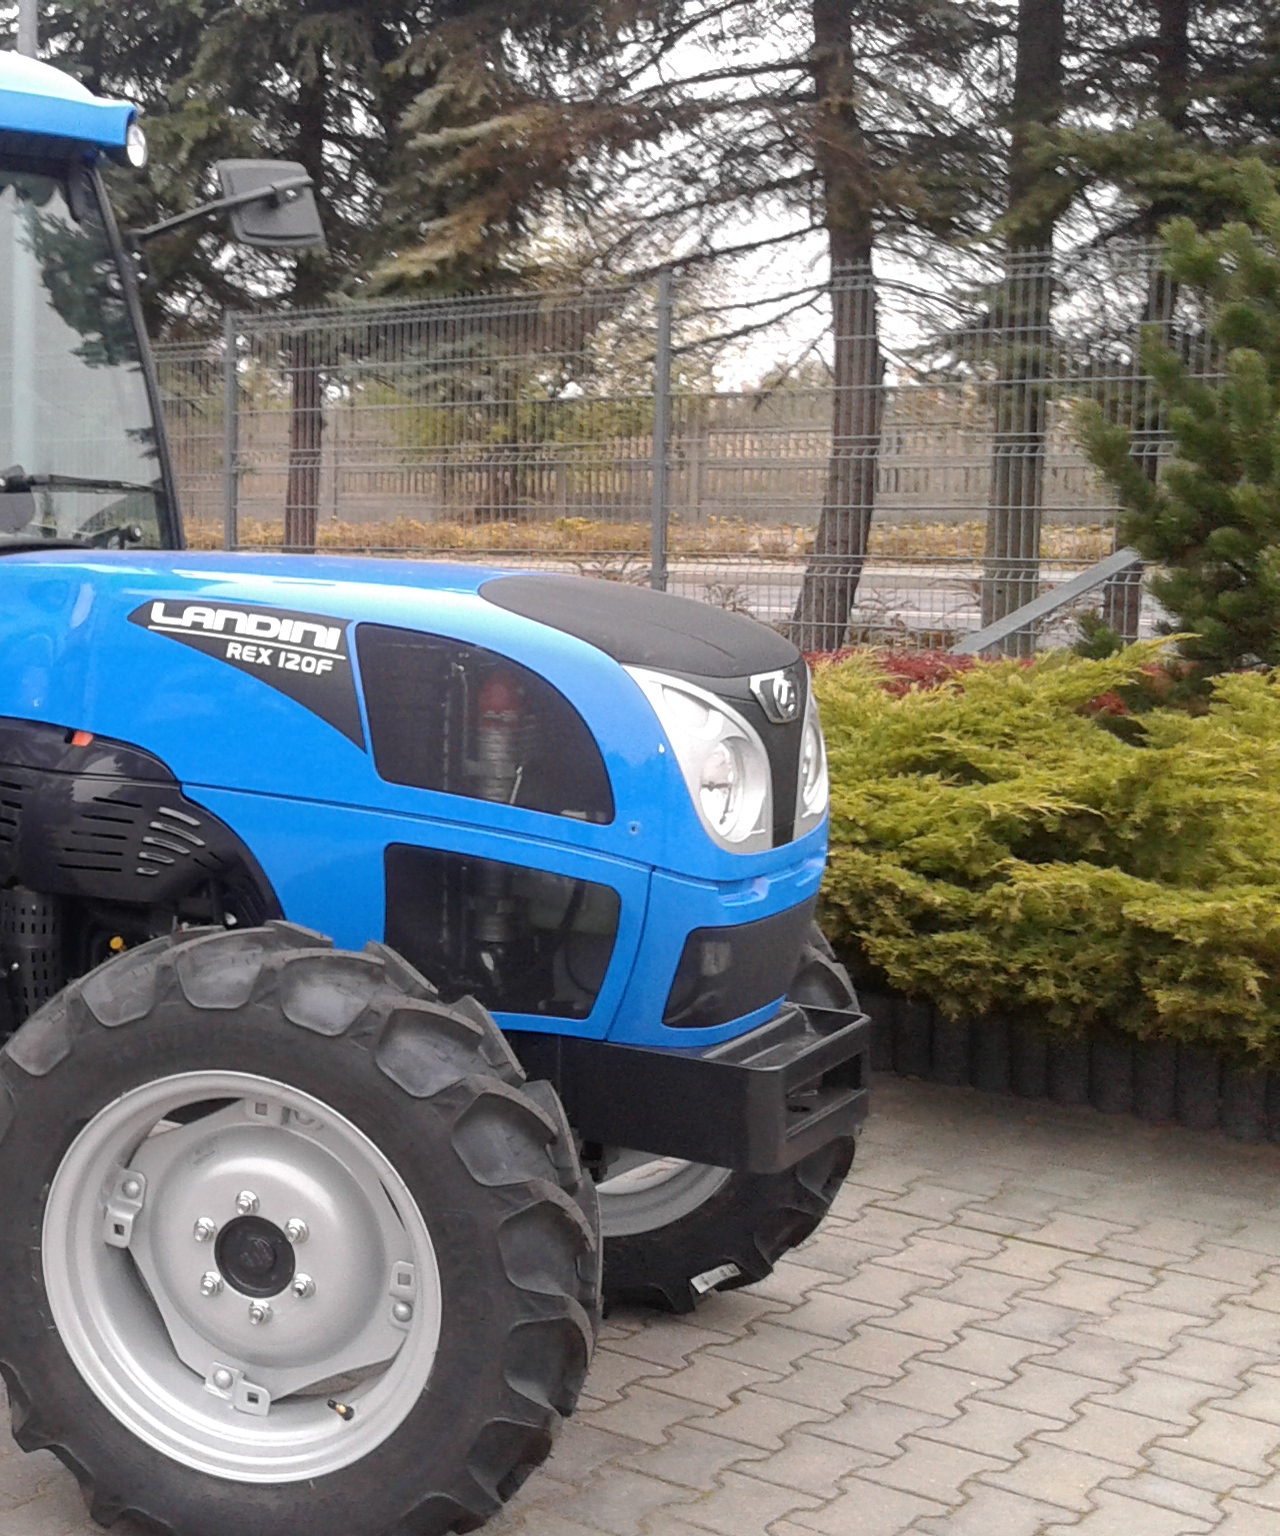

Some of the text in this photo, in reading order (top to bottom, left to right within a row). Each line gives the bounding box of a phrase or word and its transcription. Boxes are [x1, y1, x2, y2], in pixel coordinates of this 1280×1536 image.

[150, 602, 342, 651] LANDINI
[225, 641, 334, 676] REX 120F
